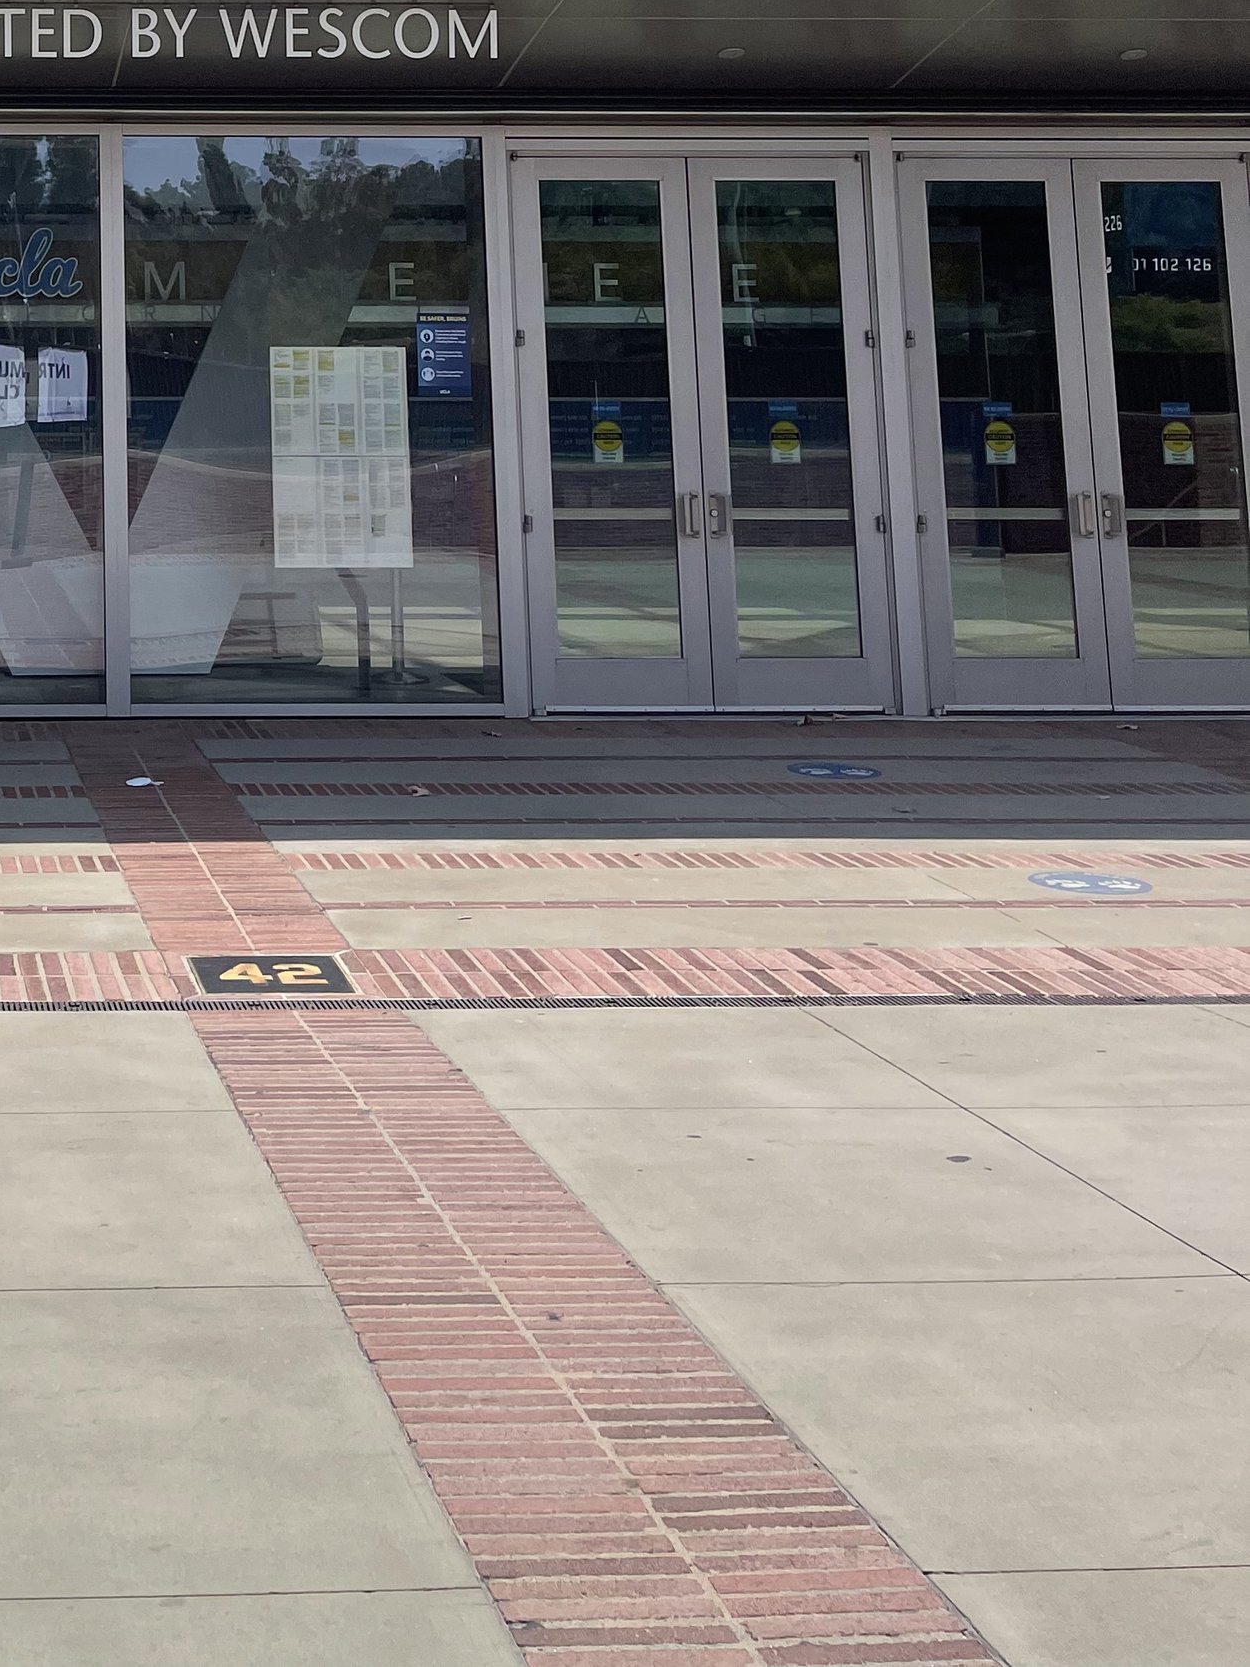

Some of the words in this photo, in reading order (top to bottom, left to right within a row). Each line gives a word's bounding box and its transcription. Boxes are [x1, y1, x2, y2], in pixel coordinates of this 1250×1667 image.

[131, 7, 198, 59] BY
[219, 7, 498, 59] WESCOM
[1104, 214, 1123, 232] 226
[1152, 257, 1179, 272] 102
[1186, 257, 1212, 272] 126
[219, 963, 328, 985] 42
